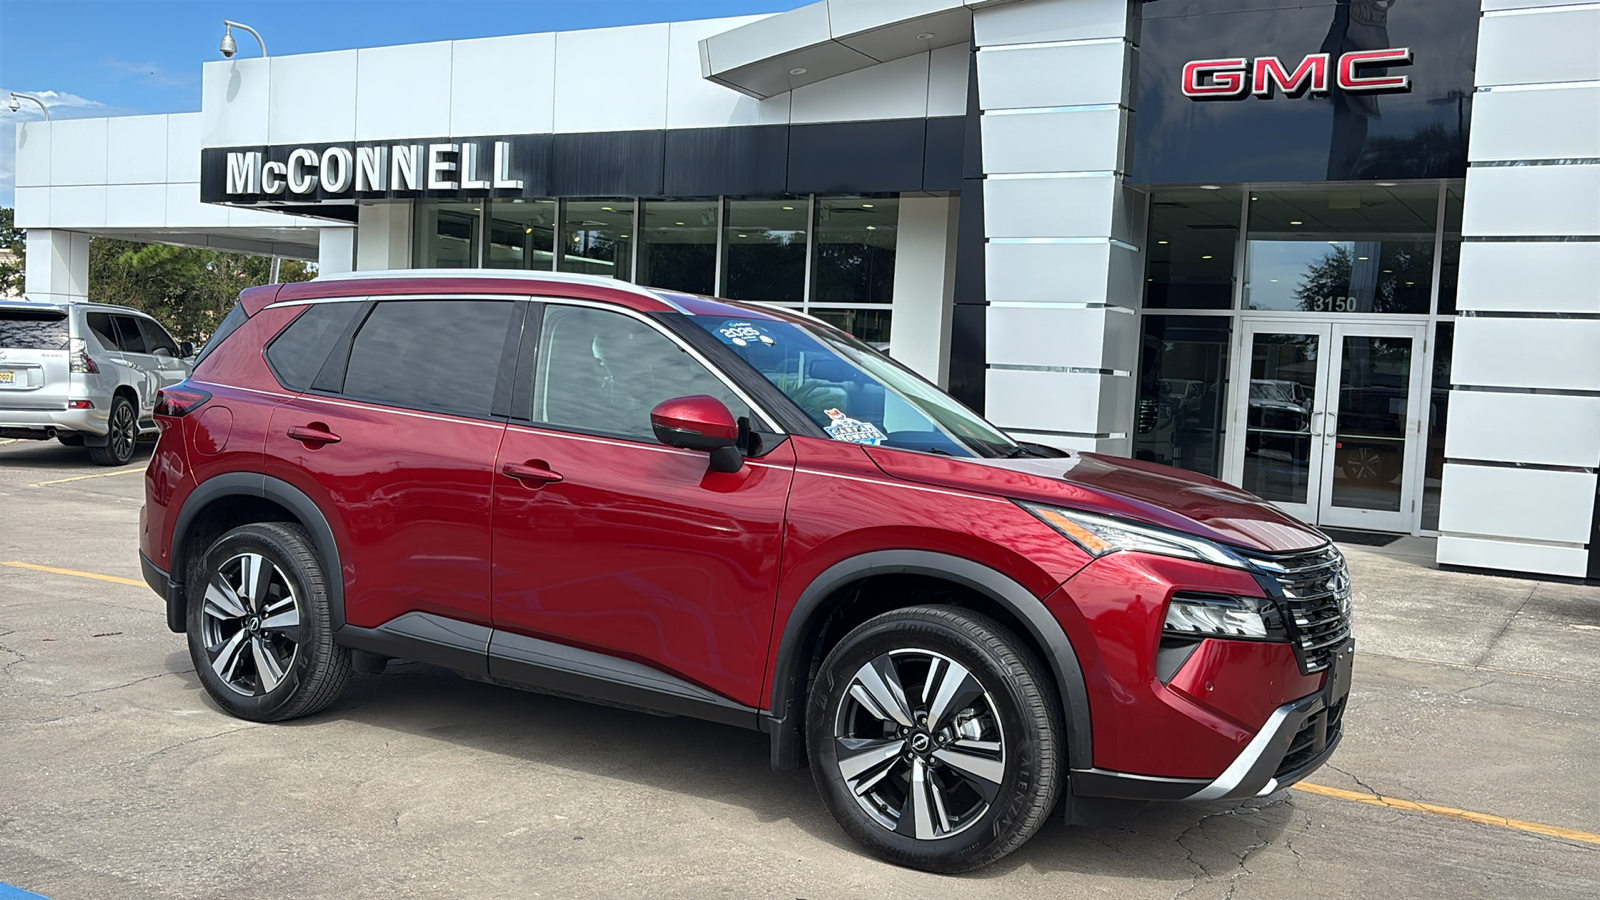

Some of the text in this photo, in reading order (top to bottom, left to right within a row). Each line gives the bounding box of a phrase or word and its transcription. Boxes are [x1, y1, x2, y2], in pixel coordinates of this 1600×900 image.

[1181, 47, 1412, 98] GMC
[225, 141, 524, 195] McCONNELL
[1313, 295, 1357, 312] 3150
[719, 326, 760, 338] 2025
[893, 621, 998, 676] BRIDGESTONE
[1001, 756, 1031, 826] ALENZA
